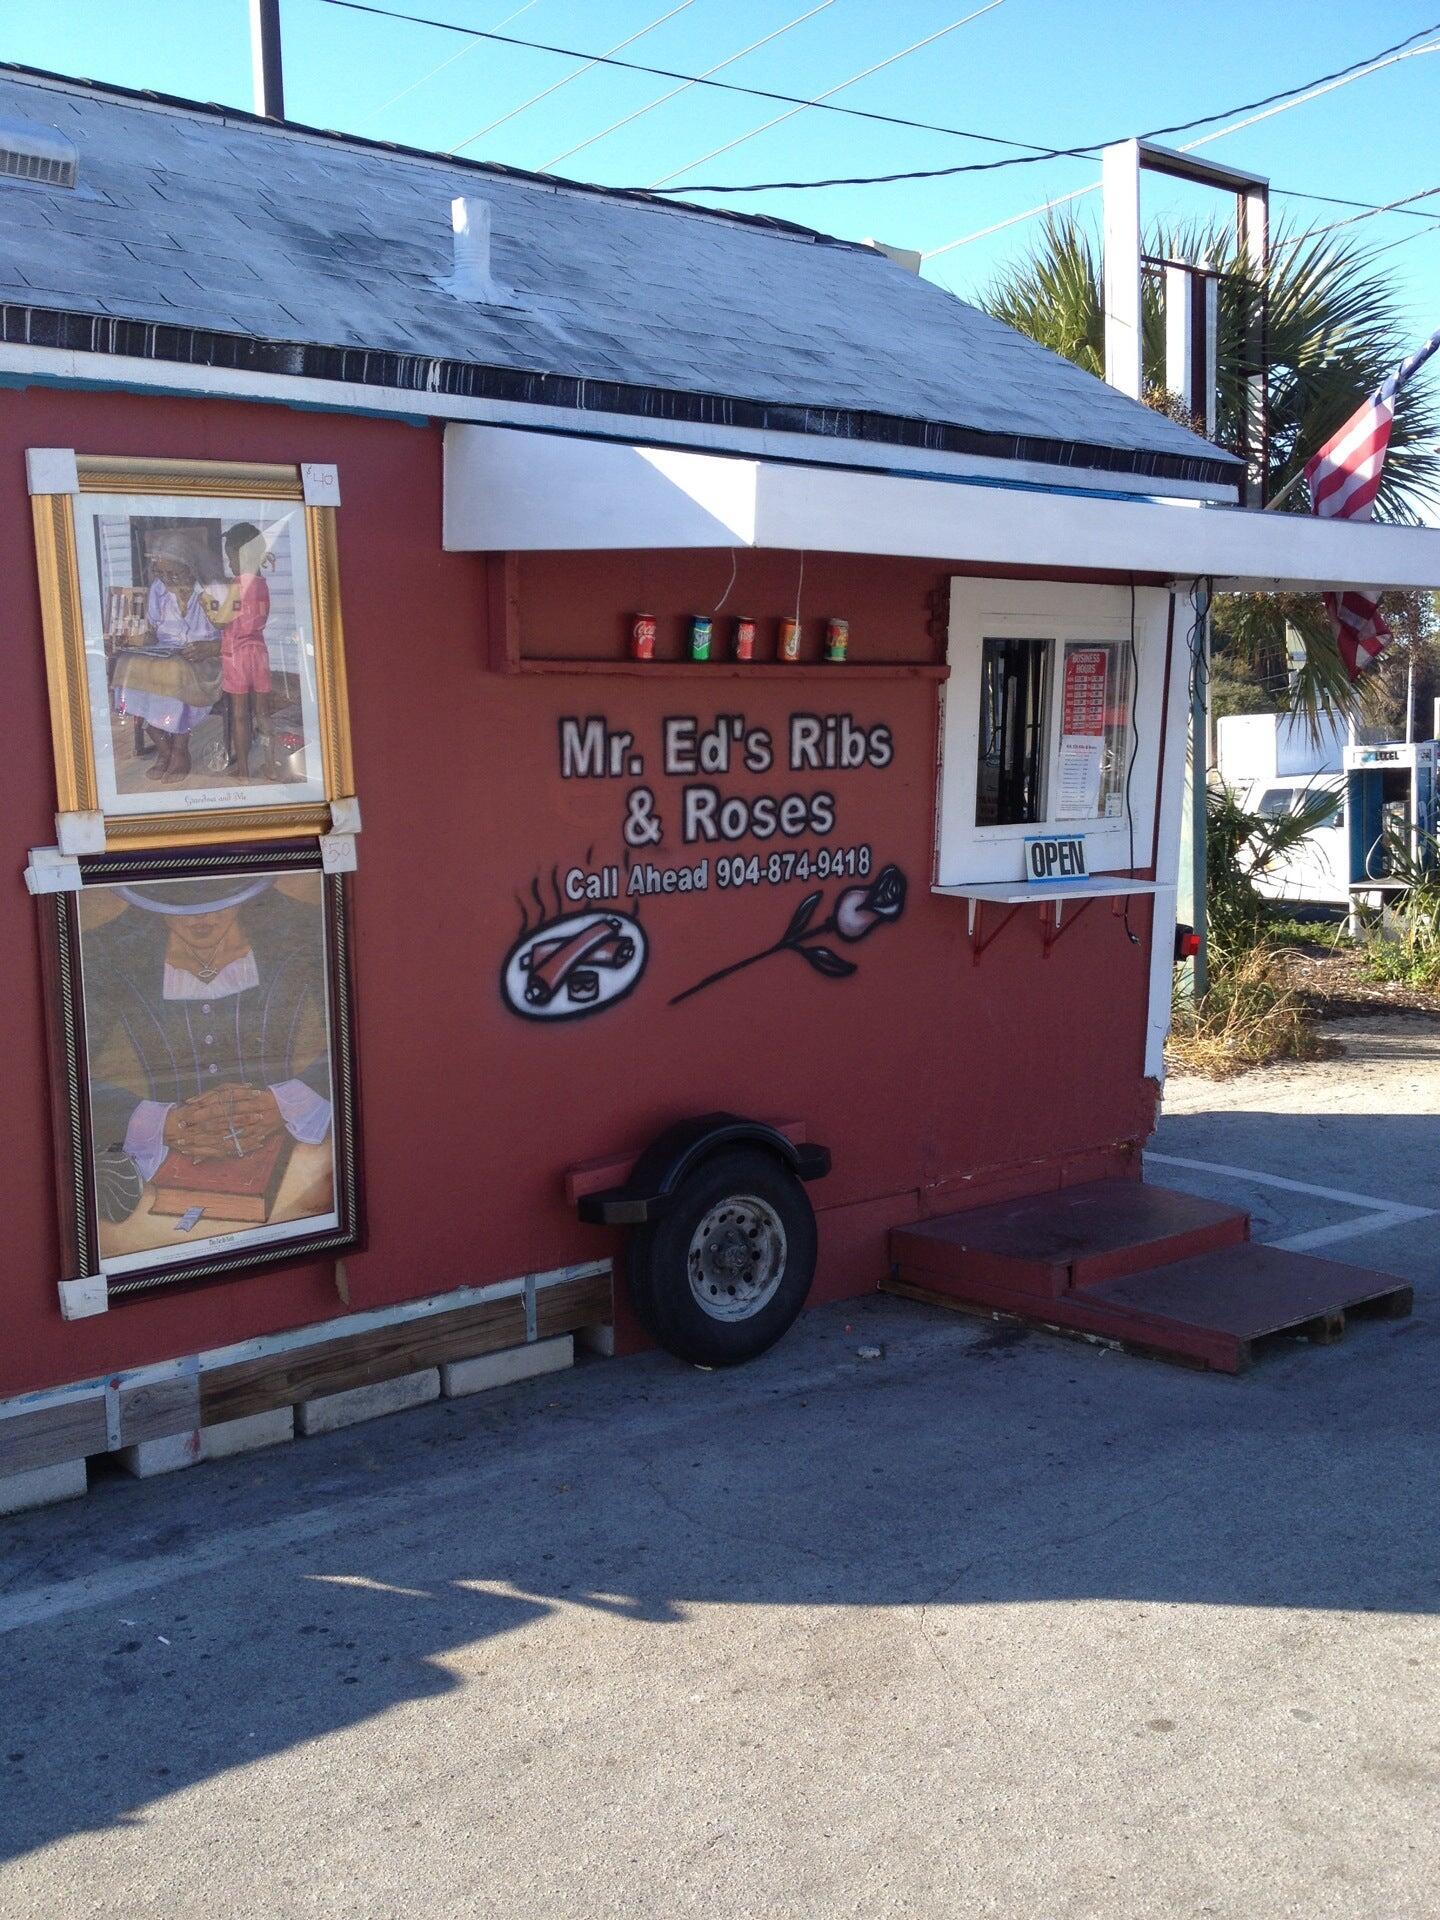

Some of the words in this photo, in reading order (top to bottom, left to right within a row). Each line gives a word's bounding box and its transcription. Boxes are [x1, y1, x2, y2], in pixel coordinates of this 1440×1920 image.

[559, 716, 643, 778] Mr.
[663, 715, 773, 774] Ed's
[789, 714, 893, 770] Ribs
[624, 785, 663, 847] &
[683, 785, 836, 842] Roses
[566, 867, 619, 900] Call
[627, 859, 709, 896] Ahead
[716, 845, 872, 888] 904-874-9418
[1031, 840, 1087, 878] OPEN
